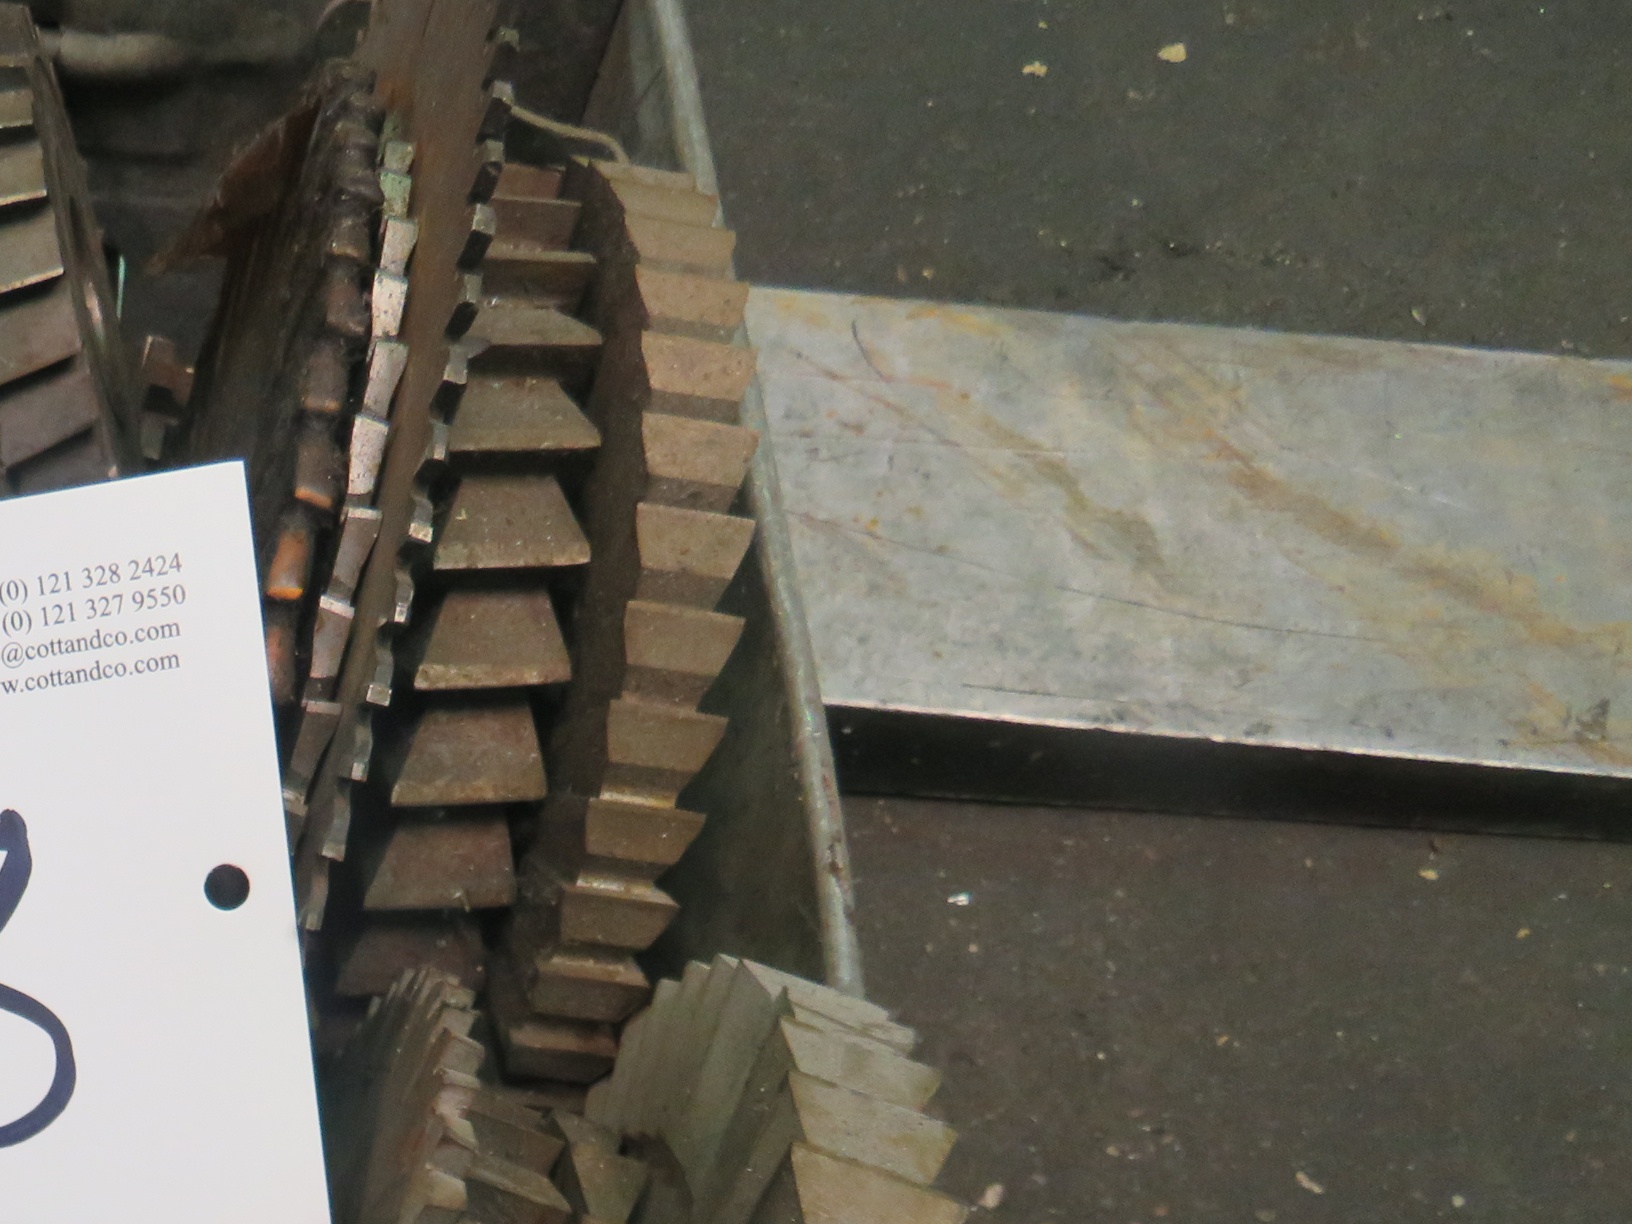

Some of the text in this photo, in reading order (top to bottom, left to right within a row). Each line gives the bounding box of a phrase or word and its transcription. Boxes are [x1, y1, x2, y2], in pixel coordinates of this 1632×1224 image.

[38, 571, 72, 596] 121
[81, 562, 121, 590] 328
[128, 552, 183, 581] 2424
[2, 610, 32, 638] (0)
[41, 602, 76, 628] 121
[86, 593, 124, 621] 327
[132, 583, 187, 613] 9550
